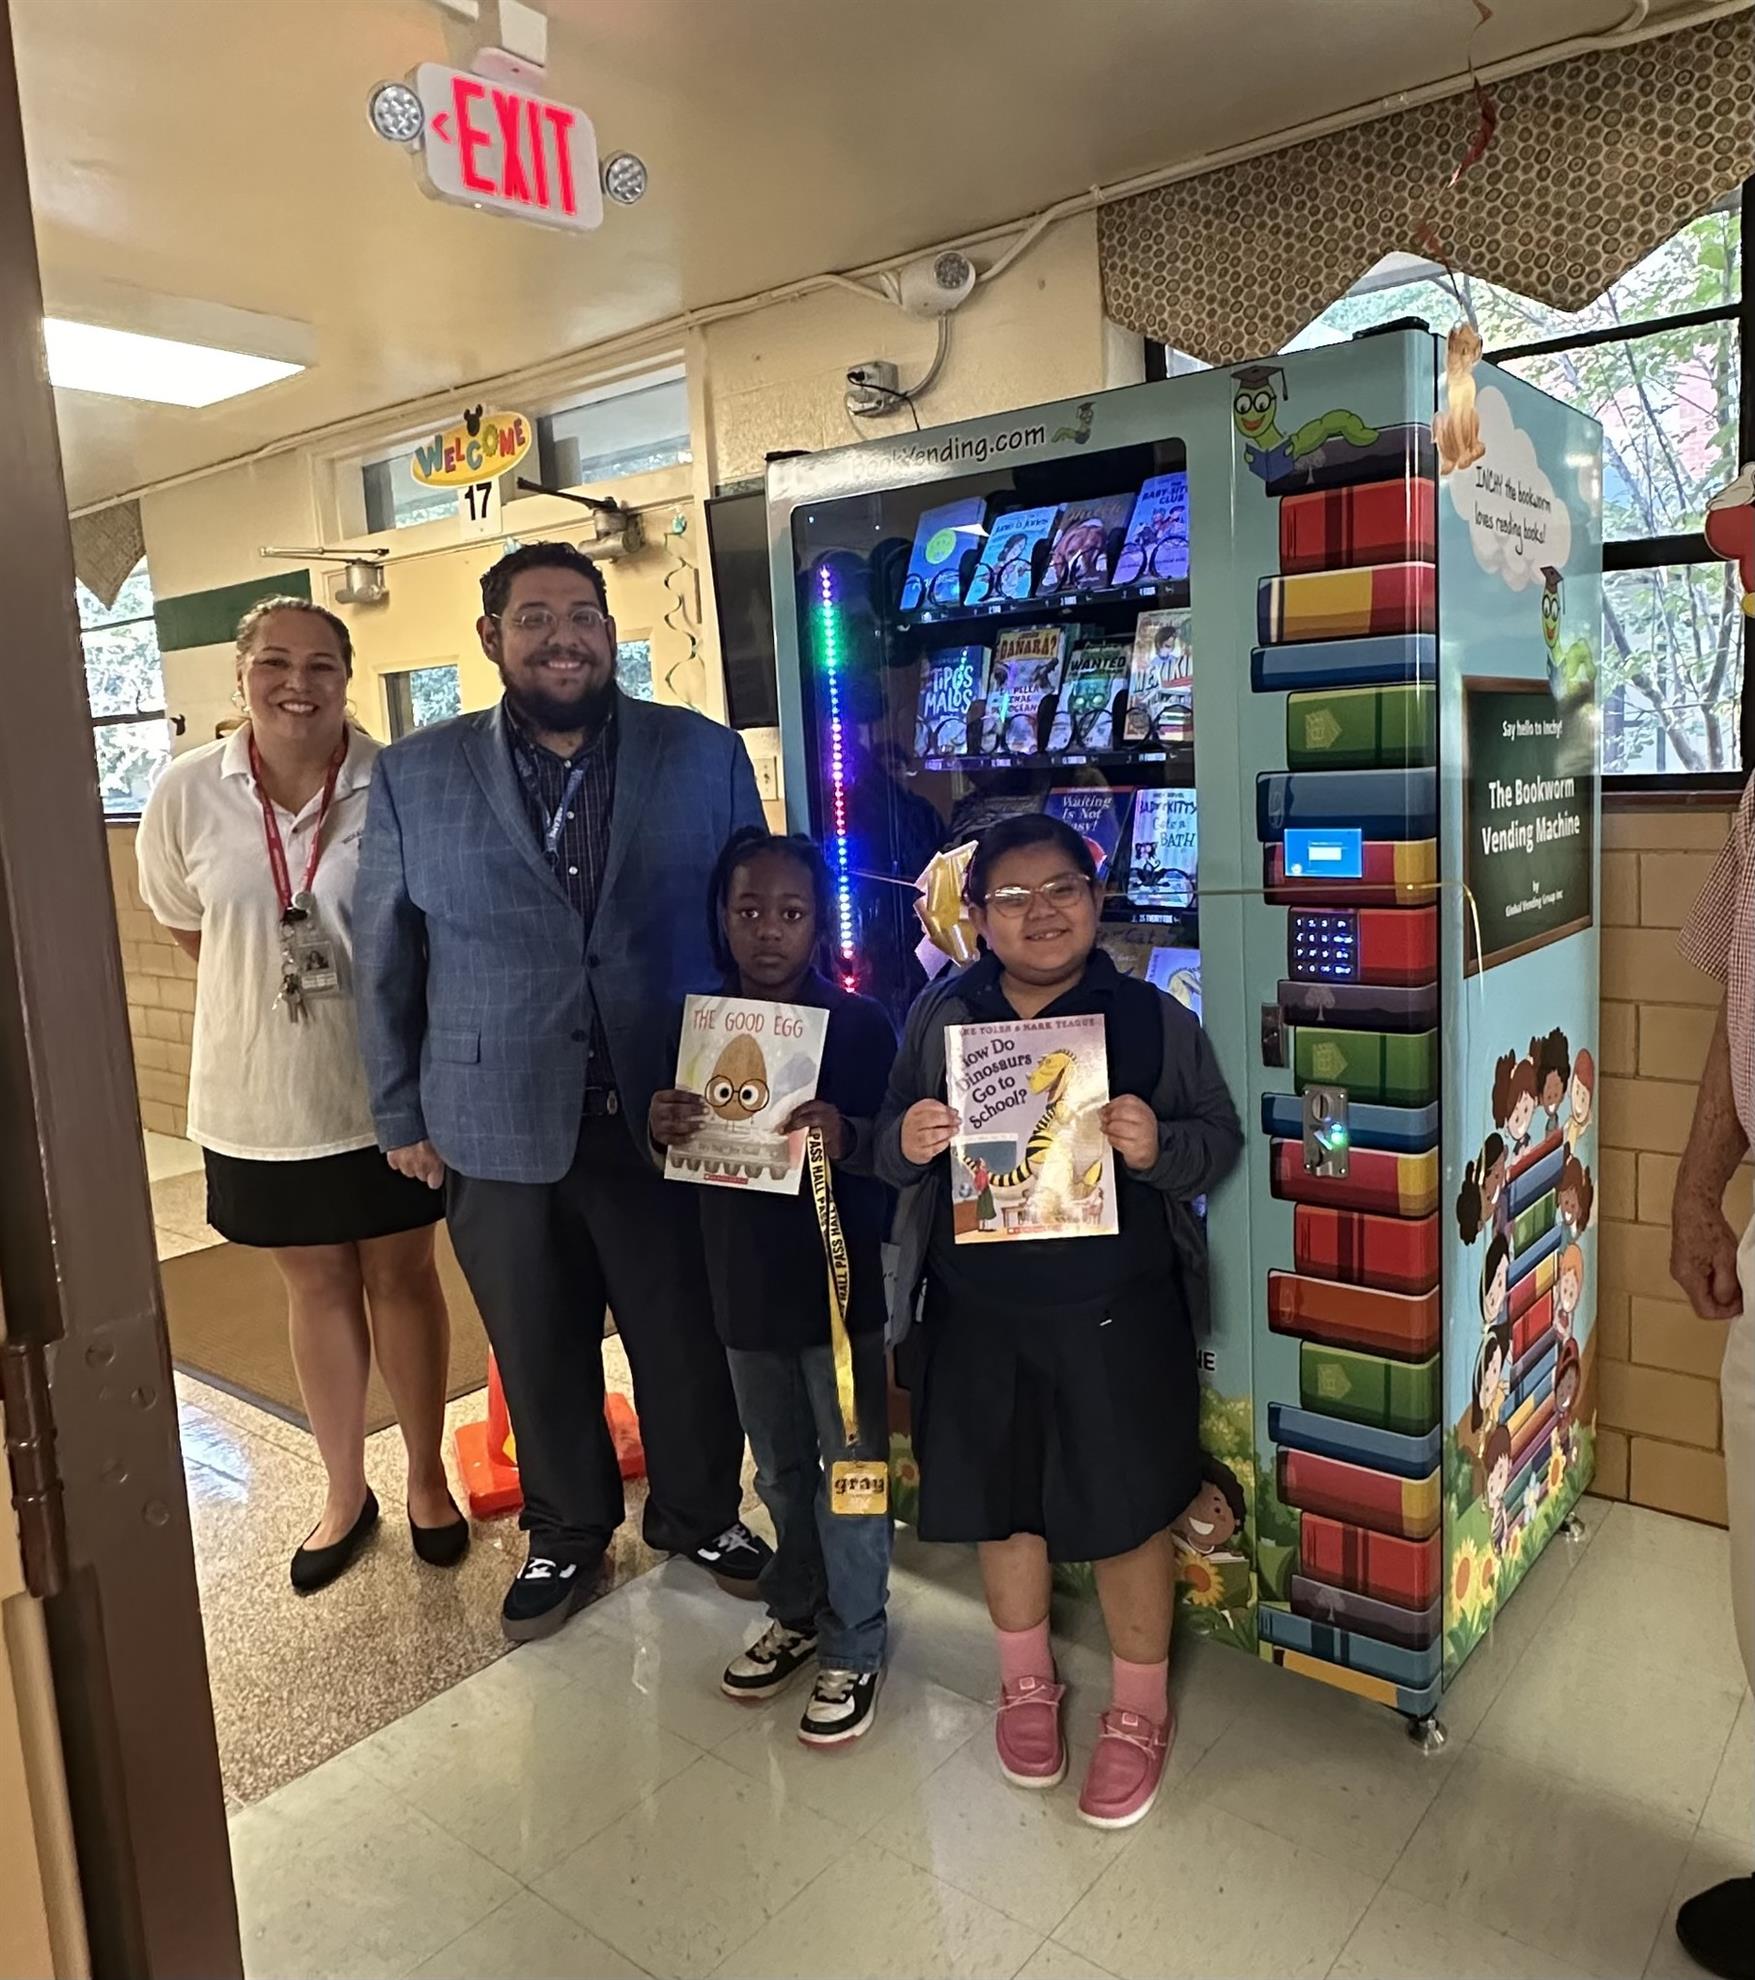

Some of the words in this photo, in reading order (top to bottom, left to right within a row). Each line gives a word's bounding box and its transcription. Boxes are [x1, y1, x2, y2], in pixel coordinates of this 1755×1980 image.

[452, 75, 576, 215] EXIT
[414, 417, 526, 478] WELCOME
[464, 481, 492, 521] 17
[1475, 466, 1502, 496] INCHY
[1505, 477, 1516, 501] the
[1518, 480, 1550, 513] bookworm
[1475, 501, 1493, 529] loves
[1496, 512, 1523, 555] reading
[1524, 518, 1546, 544] books!
[1070, 656, 1126, 670] WANTED
[924, 688, 973, 718] MALOS
[1502, 720, 1516, 741] Say
[1516, 719, 1534, 736] hello
[1534, 721, 1542, 736] to
[1542, 719, 1563, 739] Inchy!
[1063, 794, 1112, 809] Waiting
[1488, 779, 1512, 809] The
[1515, 775, 1575, 806] Bookworm
[1062, 808, 1074, 819] Is
[1082, 808, 1102, 819] Not
[1167, 800, 1197, 815] KITTY
[1160, 832, 1196, 847] BATH
[1482, 821, 1534, 855] Vending
[1536, 810, 1580, 843] Machine
[1532, 880, 1540, 894] by
[693, 1009, 717, 1030] THE
[725, 1011, 764, 1033] GOOD
[774, 1015, 803, 1038] EGG
[1023, 1022, 1052, 1031] MARK
[1055, 1018, 1095, 1028] TEAGUE
[991, 1039, 1015, 1055] Do
[956, 1054, 1032, 1091] Dinosaurs
[972, 1084, 996, 1103] Go
[998, 1076, 1015, 1090] to
[969, 1089, 1028, 1129] School?
[809, 1133, 823, 1163] PASS
[812, 1166, 825, 1195] HALL
[832, 1239, 846, 1268] PASS
